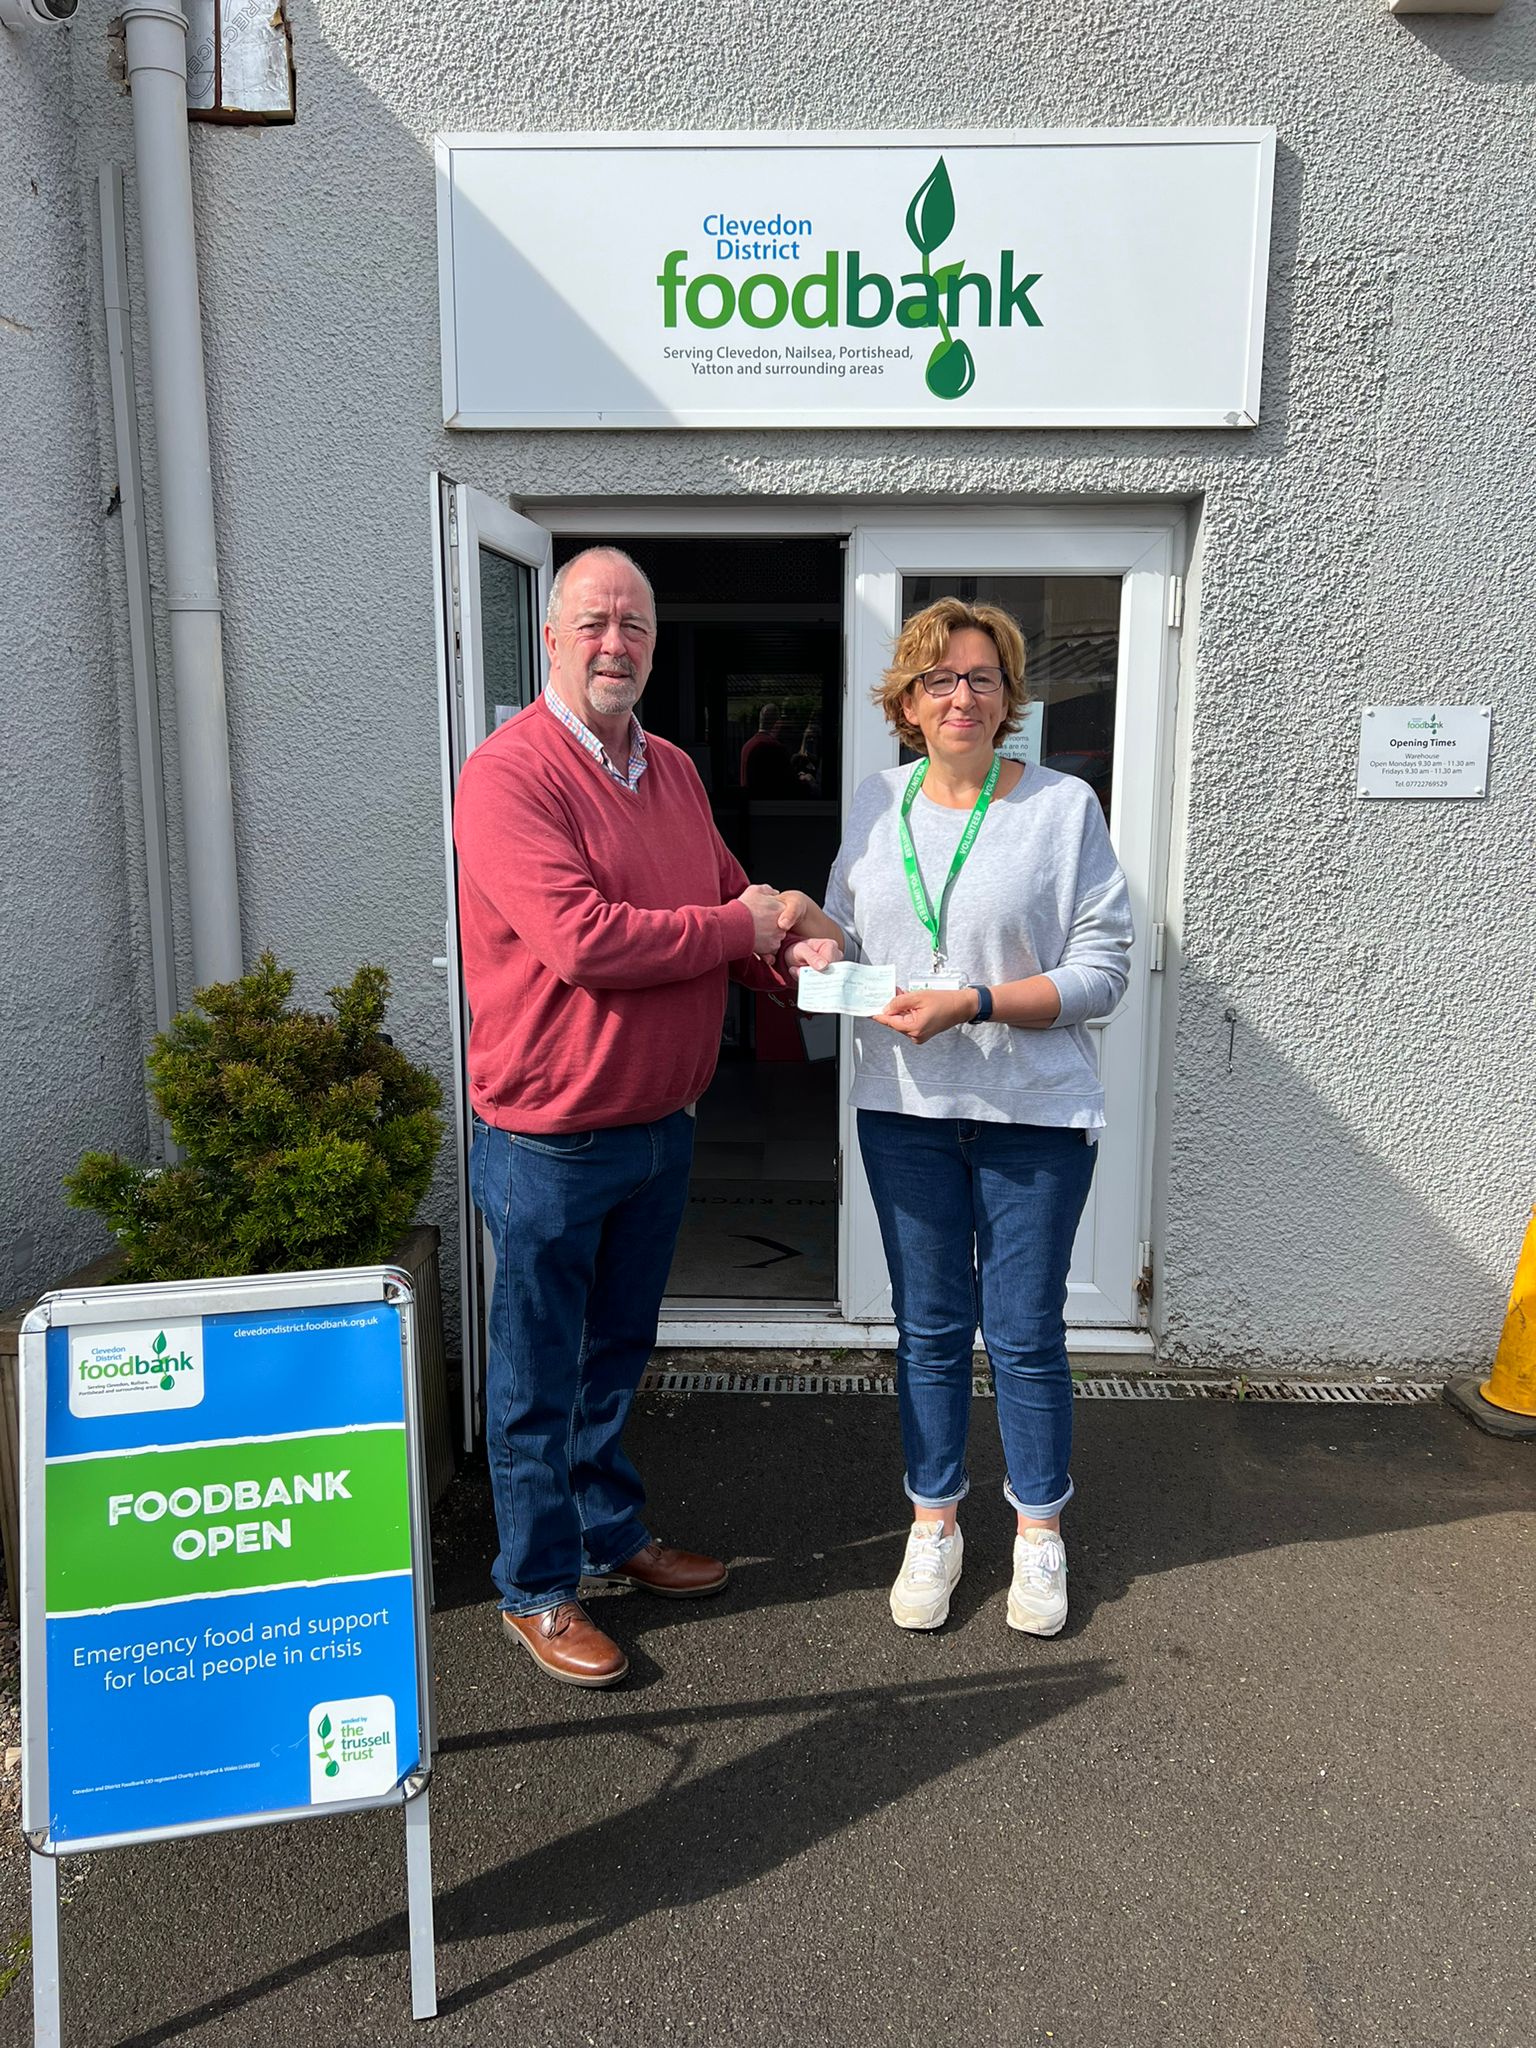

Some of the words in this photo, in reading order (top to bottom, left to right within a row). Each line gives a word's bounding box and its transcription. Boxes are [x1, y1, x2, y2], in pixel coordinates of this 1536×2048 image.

[187, 0, 260, 79] RECTICE
[703, 213, 813, 237] Clevedon
[716, 238, 800, 261] District
[656, 250, 1044, 329] foodbank
[663, 346, 714, 361] Serving
[716, 346, 782, 360] Clevedon,
[785, 346, 836, 360] Nailsea,
[839, 346, 914, 360] Portishead,
[691, 362, 734, 375] Yatton
[736, 362, 762, 375] and
[765, 362, 846, 377] surrounding
[849, 365, 884, 375] areas
[1407, 720, 1443, 729] foodbank
[1389, 738, 1429, 748] Opening
[1430, 738, 1456, 747] Times
[904, 763, 927, 805] VOLUNTEER
[959, 809, 982, 855] VOLUNTEER
[909, 872, 929, 923] VOLUNTEER
[233, 1316, 378, 1338] clevedondistrict.foodbank.org.uk
[91, 1346, 126, 1356] Clevedon
[96, 1354, 122, 1362] District
[78, 1351, 194, 1380] foodbank
[108, 1469, 352, 1527] FOODBANK
[172, 1518, 292, 1561] OPEN
[73, 1633, 198, 1667] Emergency
[203, 1623, 254, 1648] food
[261, 1616, 301, 1641] and
[307, 1607, 390, 1637] support
[103, 1671, 137, 1691] for
[143, 1660, 196, 1685] local
[202, 1650, 277, 1681] people
[283, 1645, 303, 1665] in
[310, 1638, 362, 1662] crisis
[341, 1724, 364, 1738] the
[341, 1731, 390, 1750] trussell
[341, 1748, 374, 1762] trust
